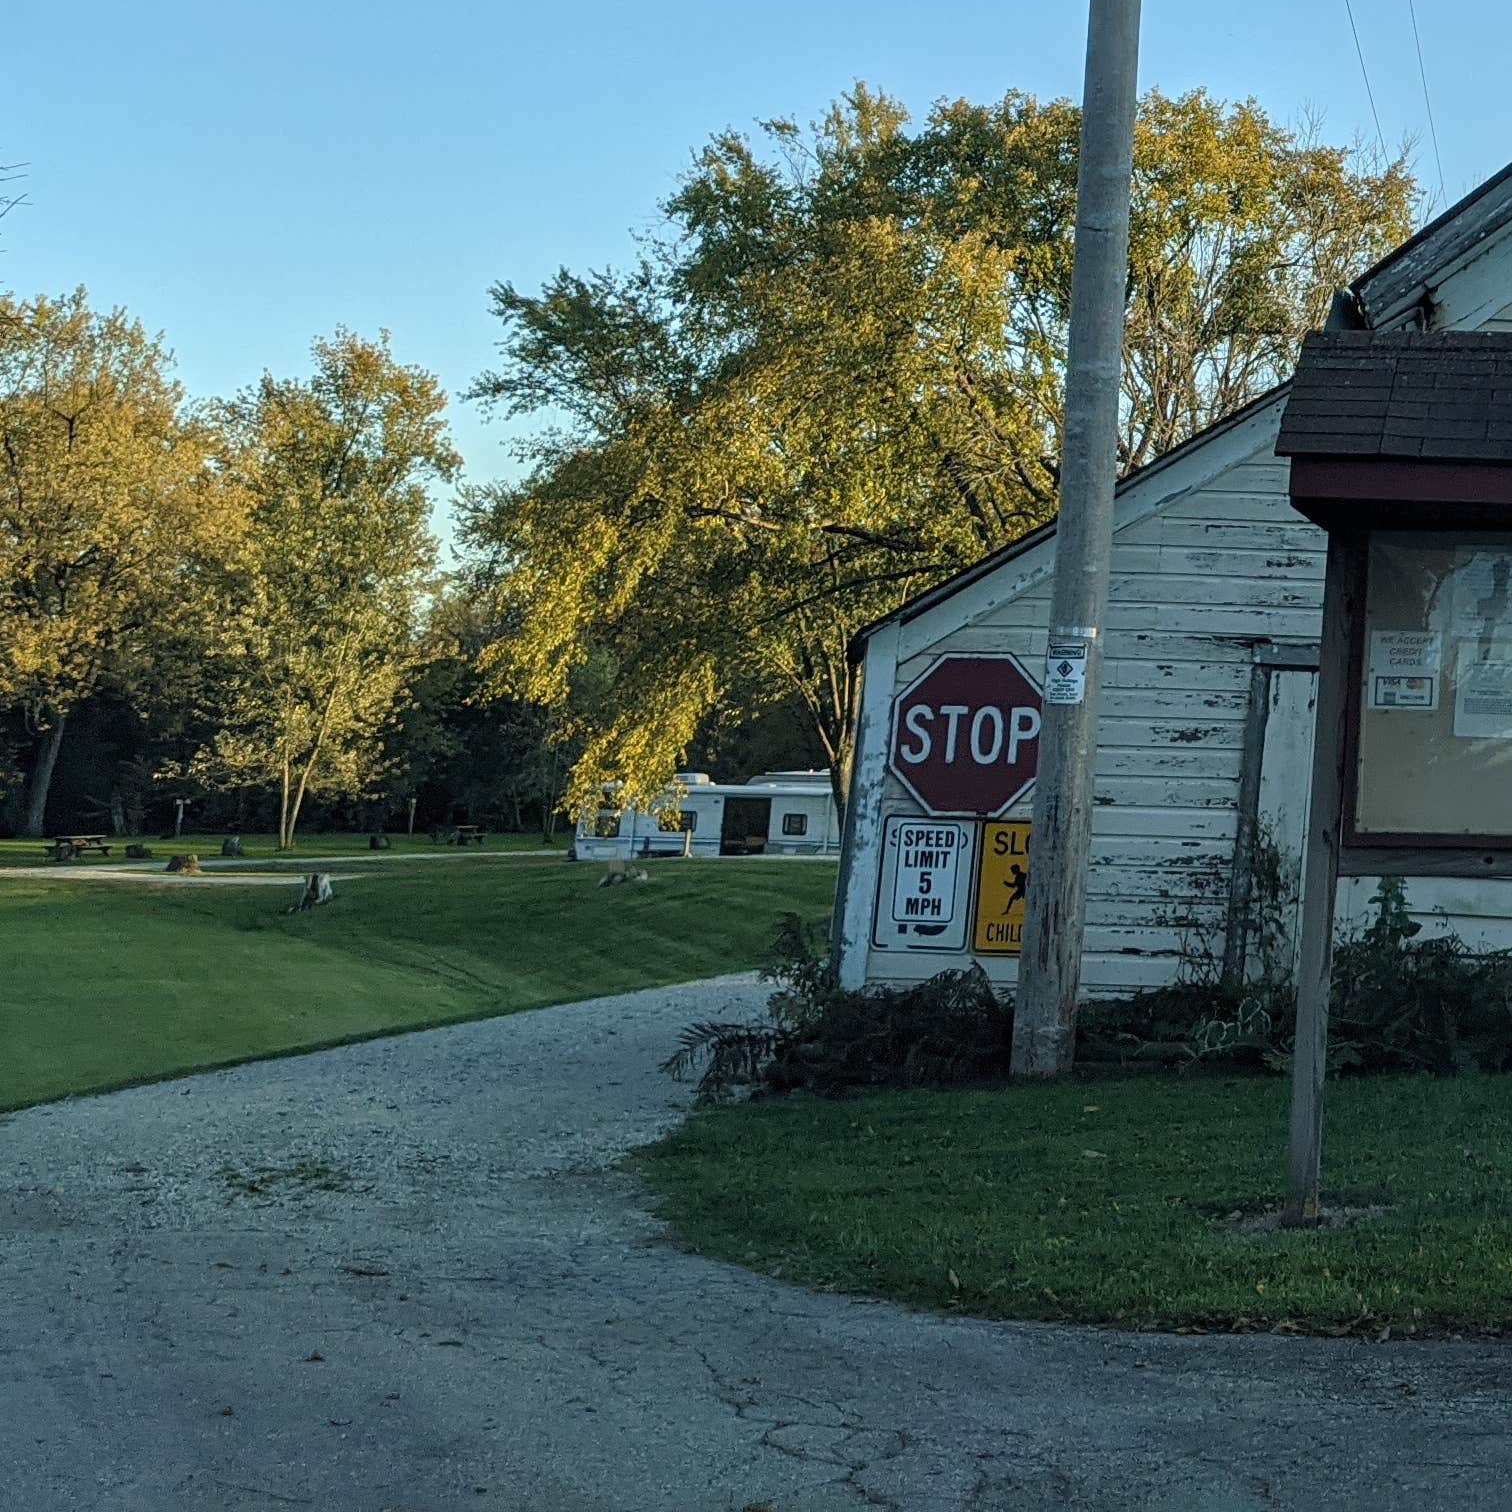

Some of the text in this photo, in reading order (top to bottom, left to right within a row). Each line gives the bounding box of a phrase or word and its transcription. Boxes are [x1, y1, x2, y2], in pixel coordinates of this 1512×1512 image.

[901, 704, 1042, 764] STOP
[903, 830, 955, 848] SPEED
[904, 851, 951, 869] LIMIT
[918, 871, 932, 894] 5
[905, 898, 942, 916] MPH
